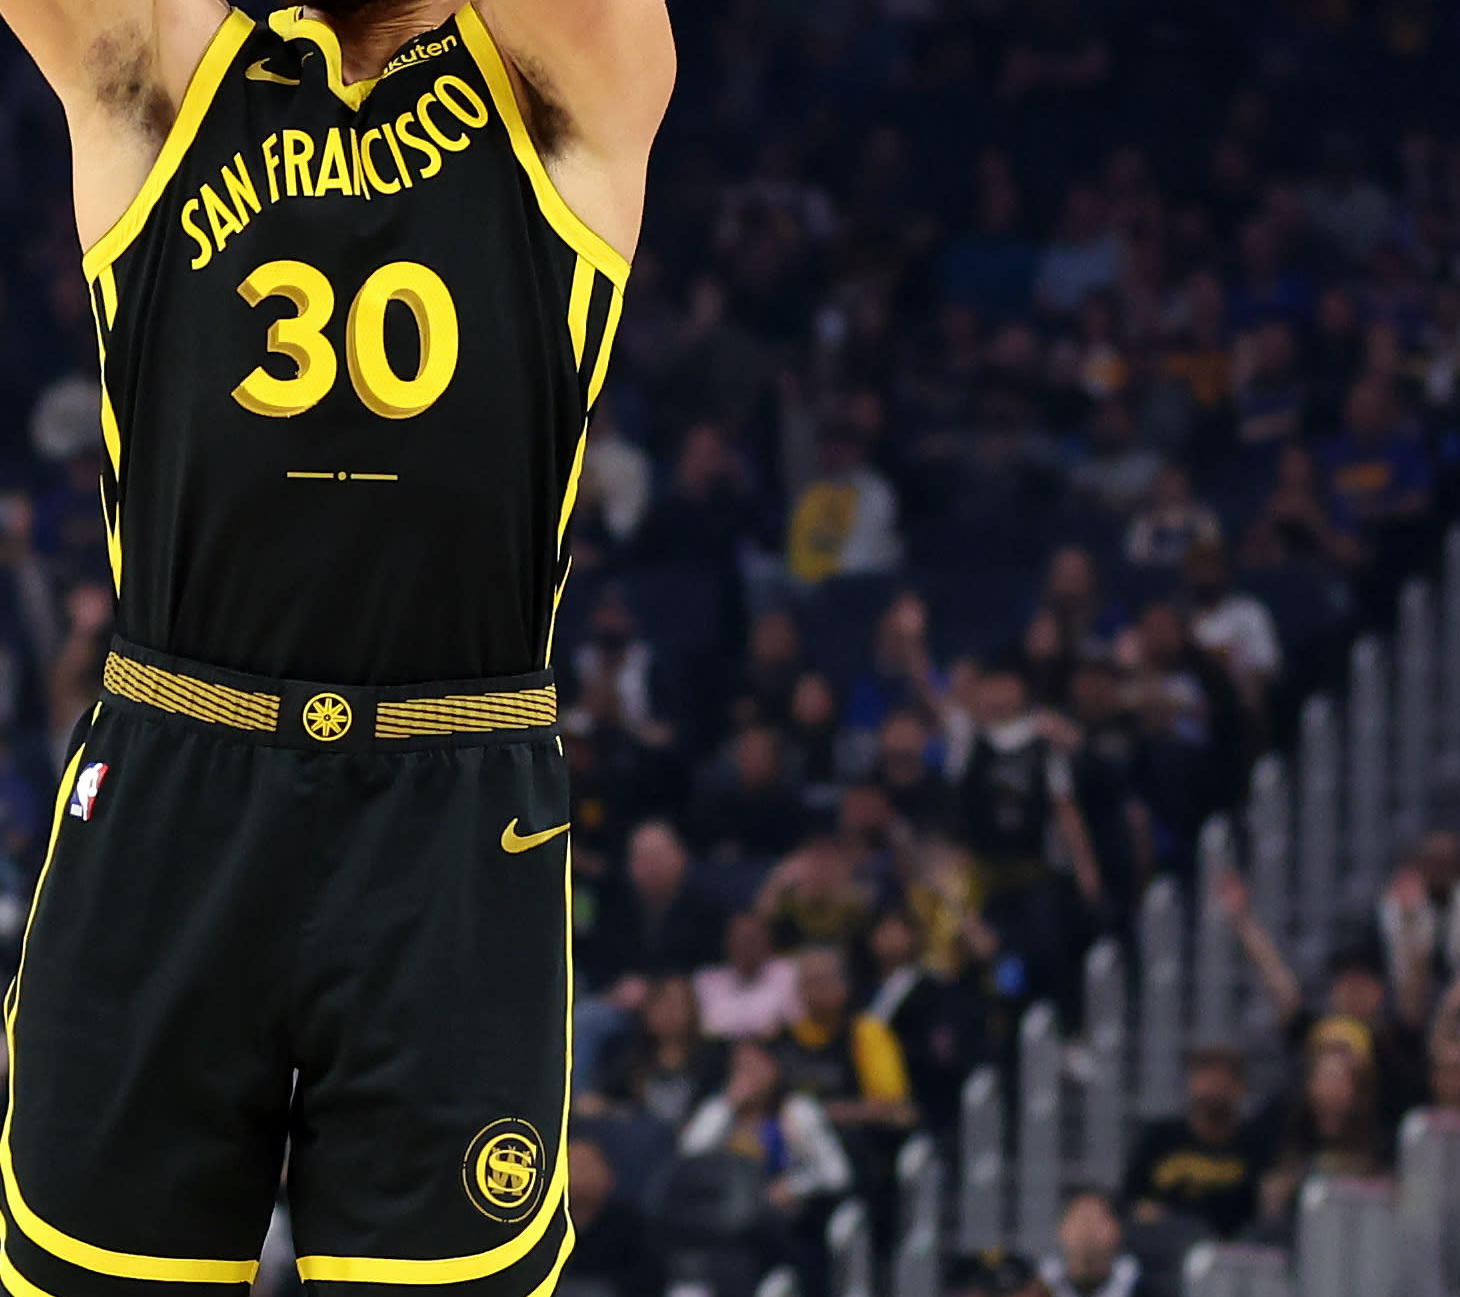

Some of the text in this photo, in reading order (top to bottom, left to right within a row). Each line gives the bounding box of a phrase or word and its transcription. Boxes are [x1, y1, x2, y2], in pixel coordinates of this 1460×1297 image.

[383, 34, 458, 74] kuten
[181, 152, 262, 270] SAN
[231, 260, 459, 420] 30
